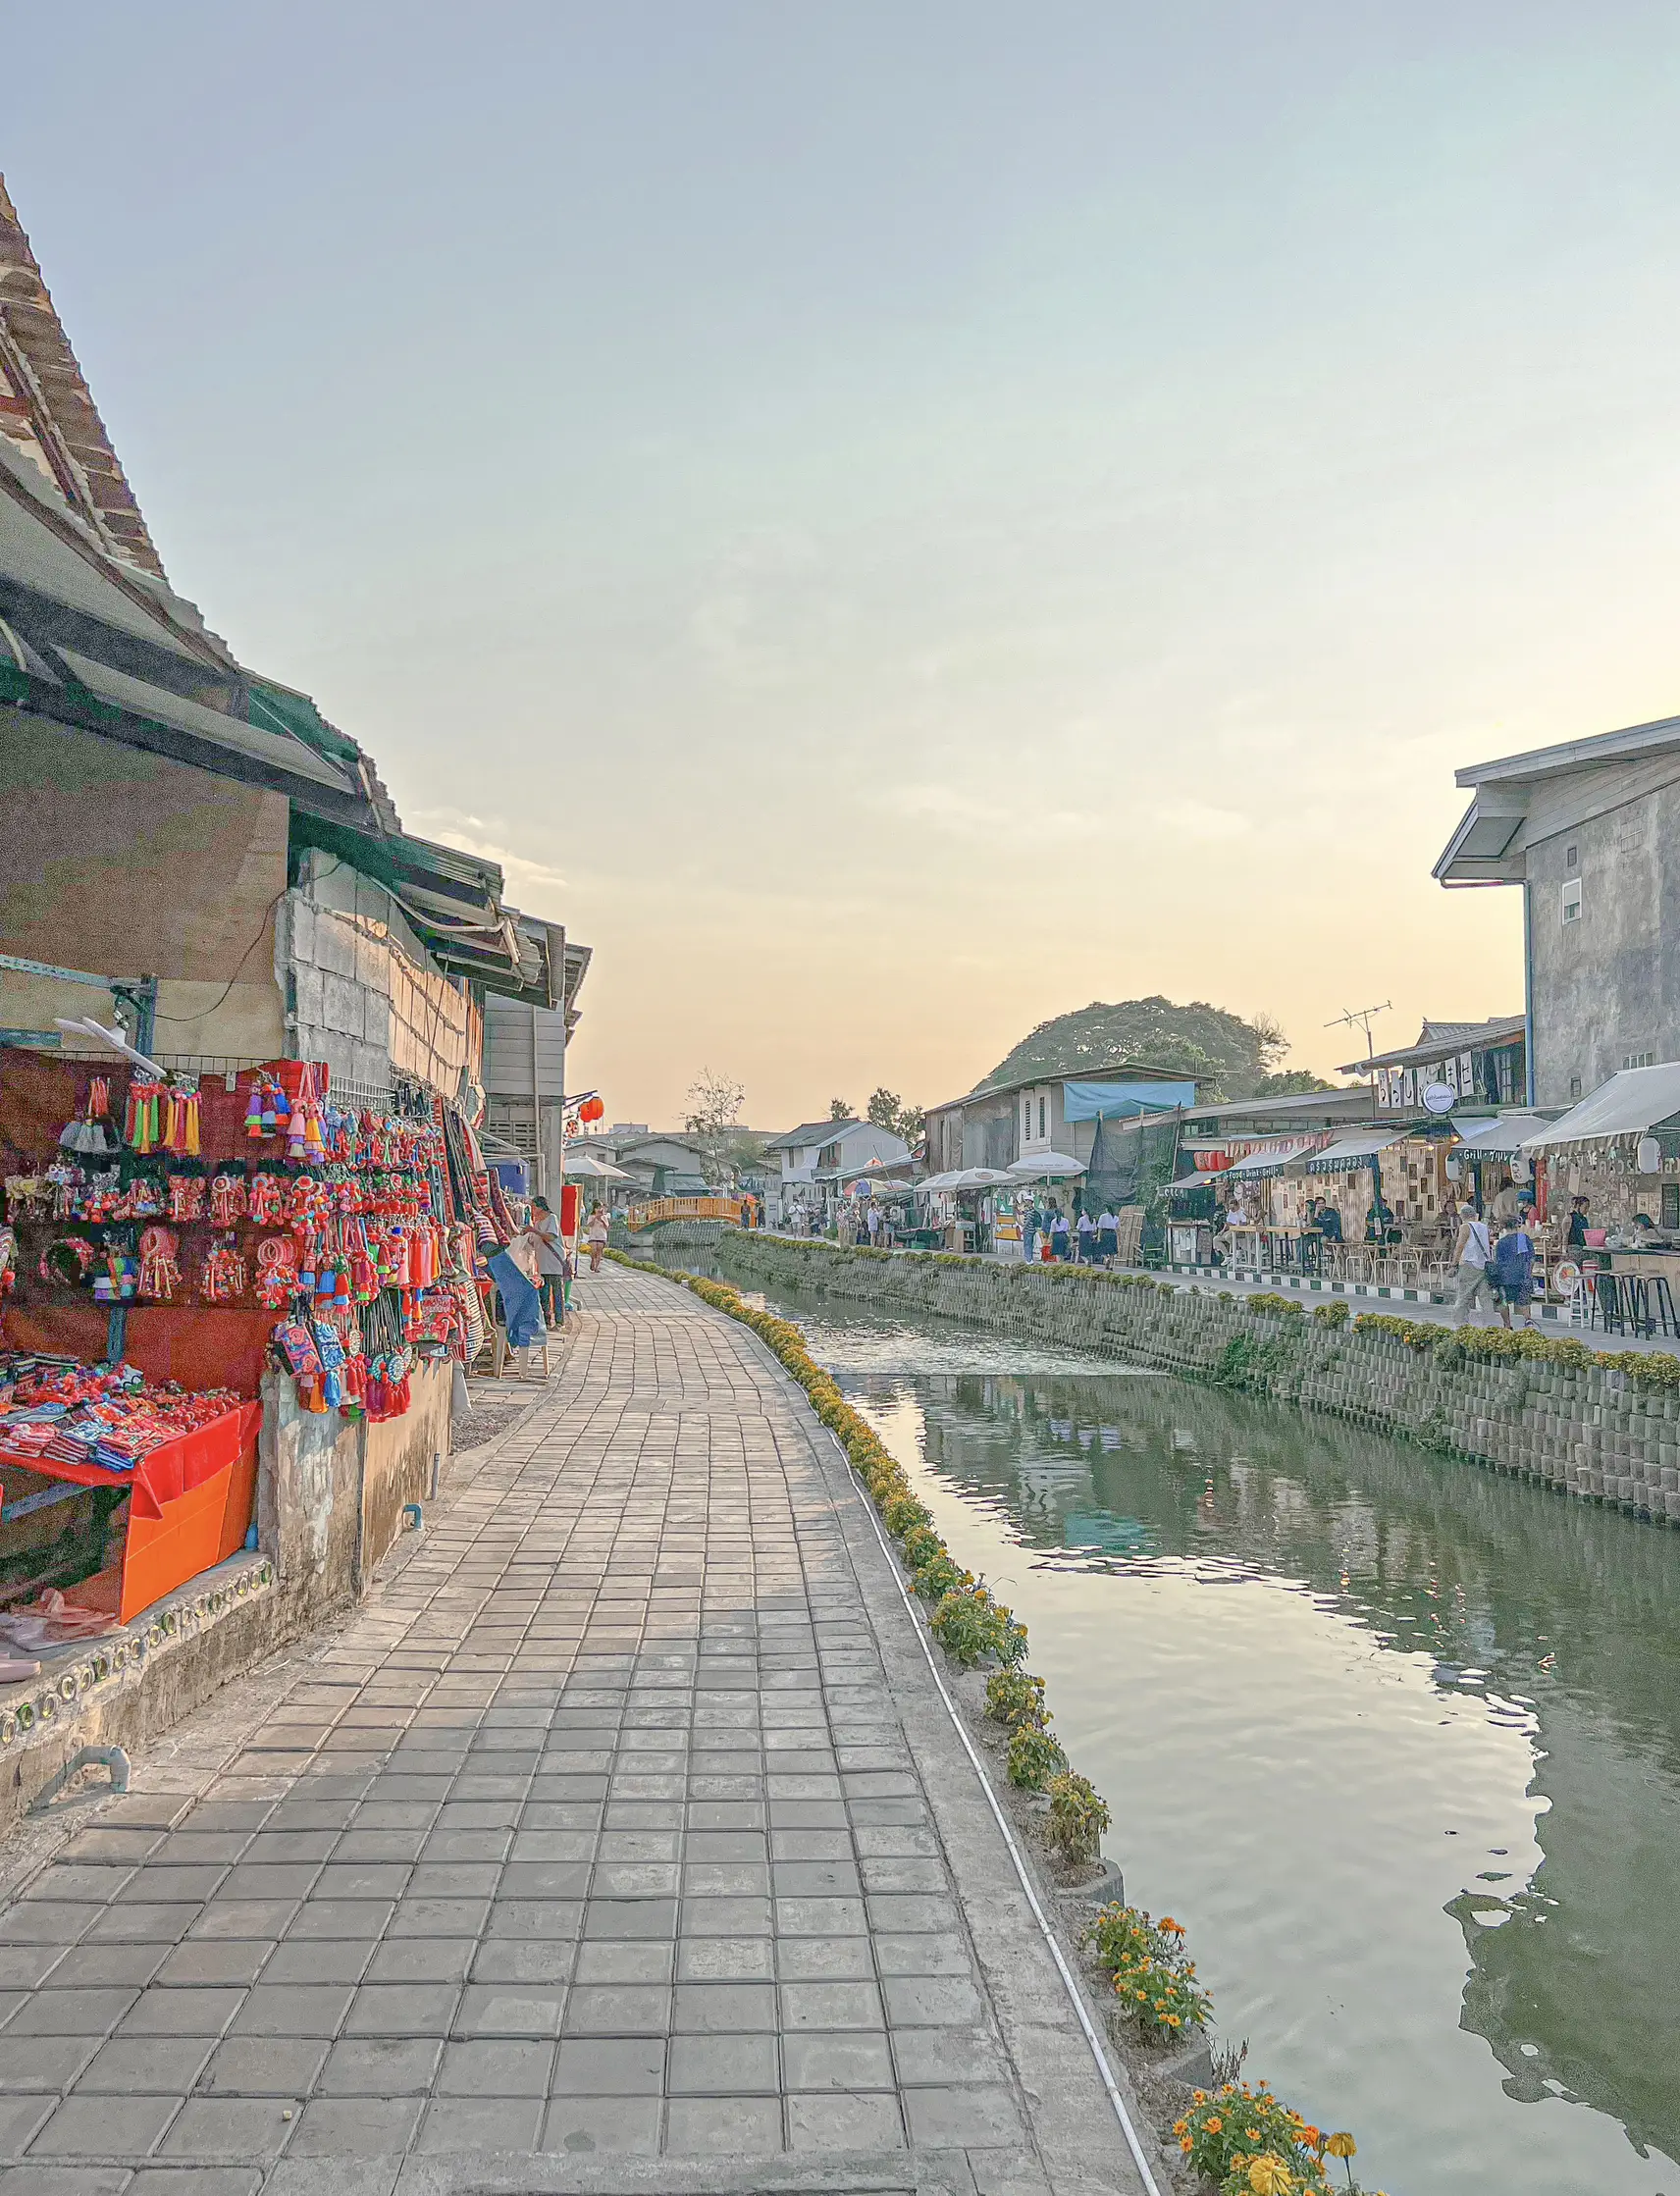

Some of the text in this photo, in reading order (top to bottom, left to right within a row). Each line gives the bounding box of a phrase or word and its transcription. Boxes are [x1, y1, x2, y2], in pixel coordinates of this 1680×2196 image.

[1463, 1149, 1483, 1160] Grill
[1229, 1165, 1276, 1179] Food Drink Grill
